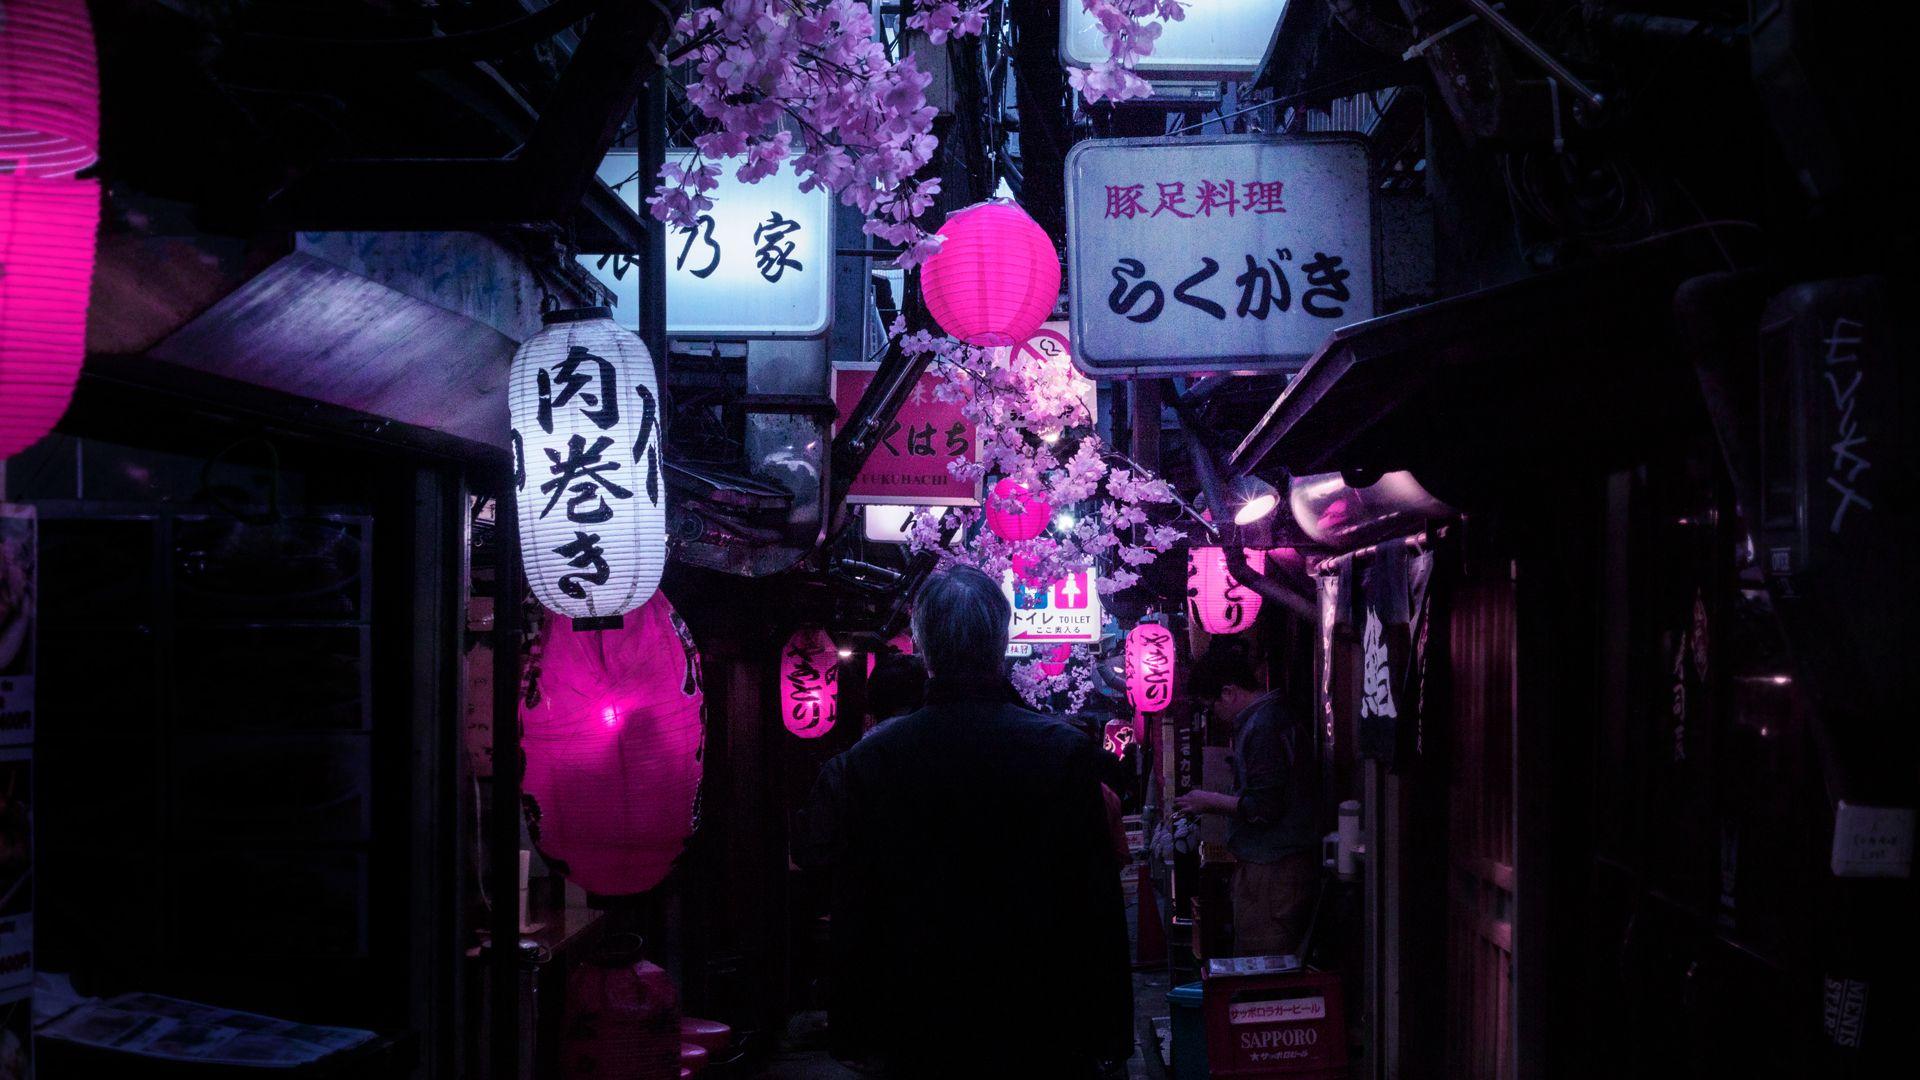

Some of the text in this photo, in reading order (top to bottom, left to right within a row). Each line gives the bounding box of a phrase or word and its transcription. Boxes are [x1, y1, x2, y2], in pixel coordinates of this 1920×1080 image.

[1104, 179, 1287, 219] 豚足料理
[1108, 248, 1350, 323] らくがき
[881, 421, 969, 457] くはち
[537, 345, 633, 599] 肉巻き
[1222, 568, 1246, 628] とり
[1013, 612, 1091, 625] トイレ TOILET
[1241, 1028, 1318, 1049] SAPPORO
